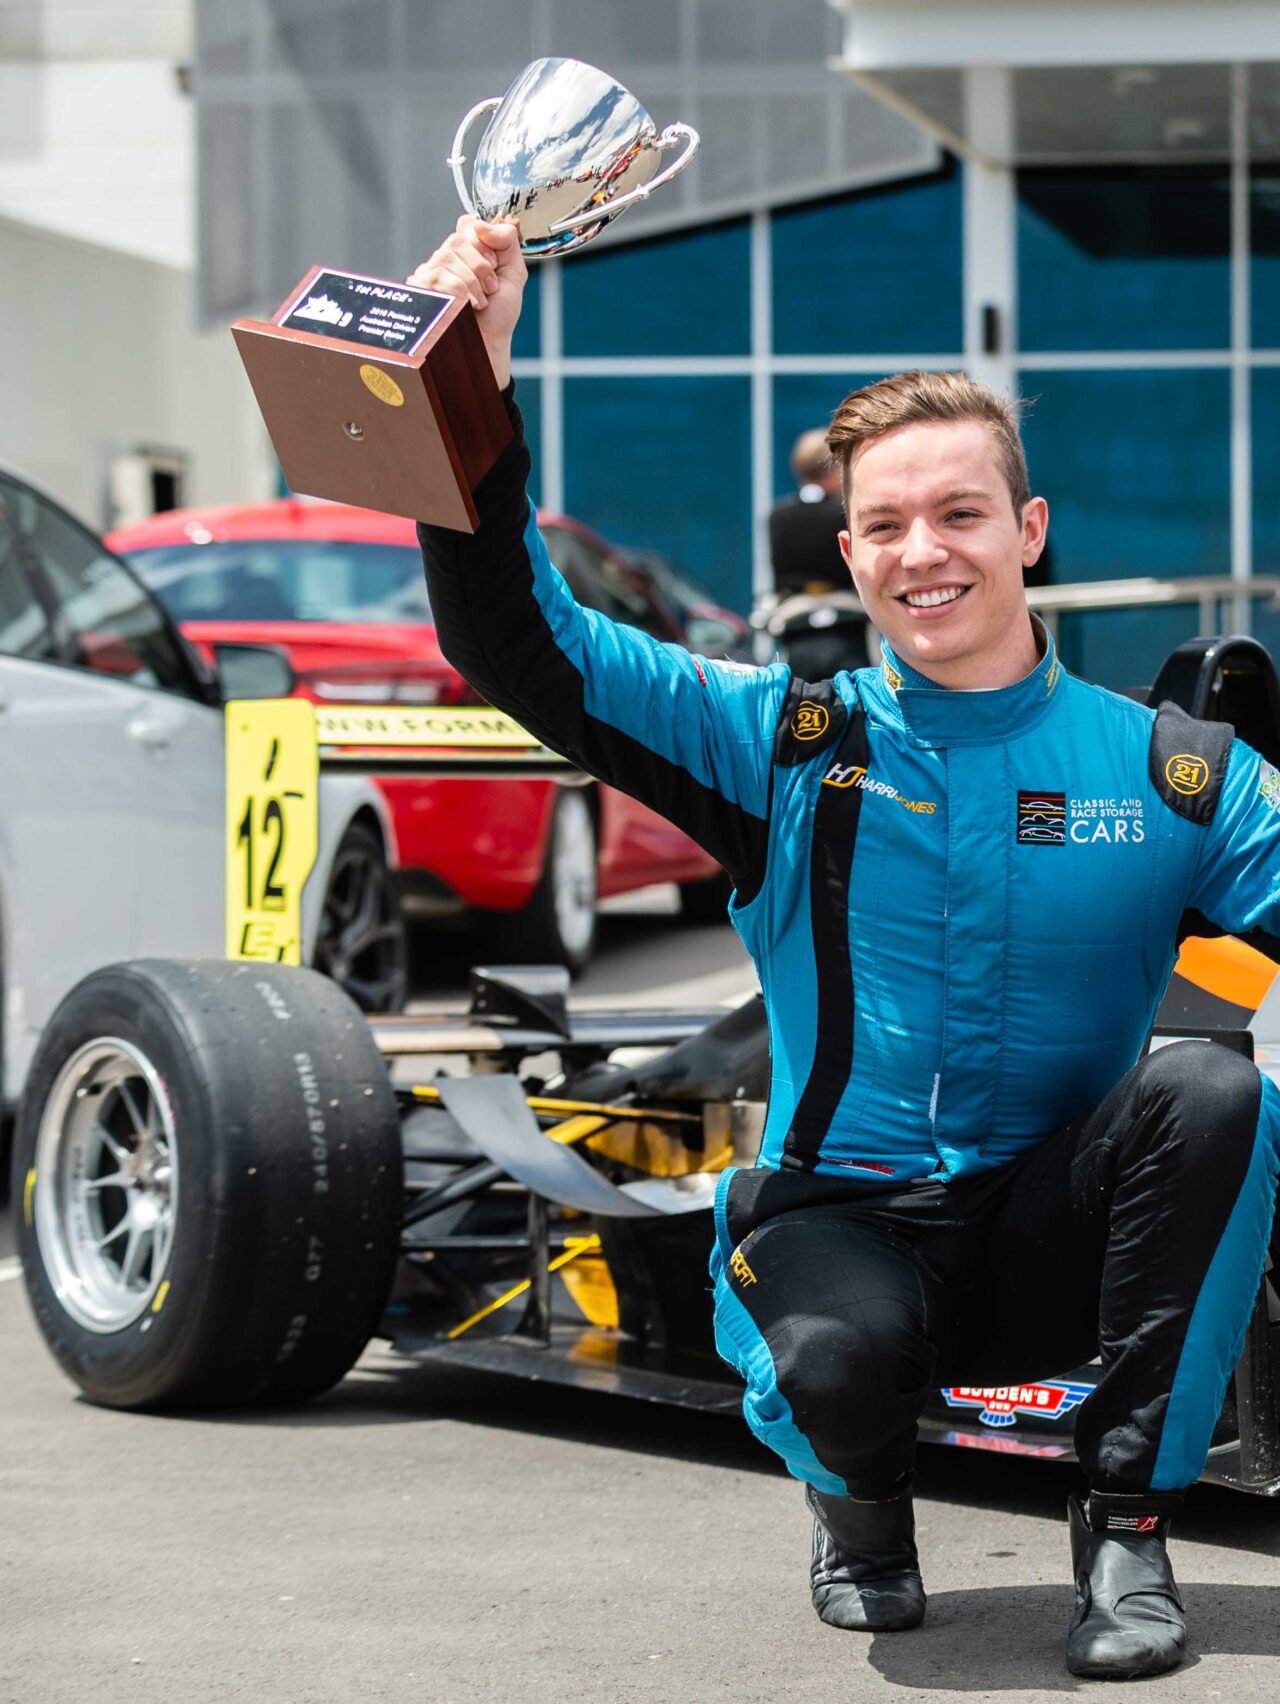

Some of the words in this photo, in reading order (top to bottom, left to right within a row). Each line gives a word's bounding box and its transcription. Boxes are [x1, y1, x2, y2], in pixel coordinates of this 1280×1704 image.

[370, 287, 410, 302] PLACE
[1070, 799, 1116, 808] CLASSIC
[1071, 808, 1097, 818] RACE
[1100, 808, 1144, 818] STORAGE
[1070, 819, 1145, 843] CARS
[236, 796, 286, 912] 12
